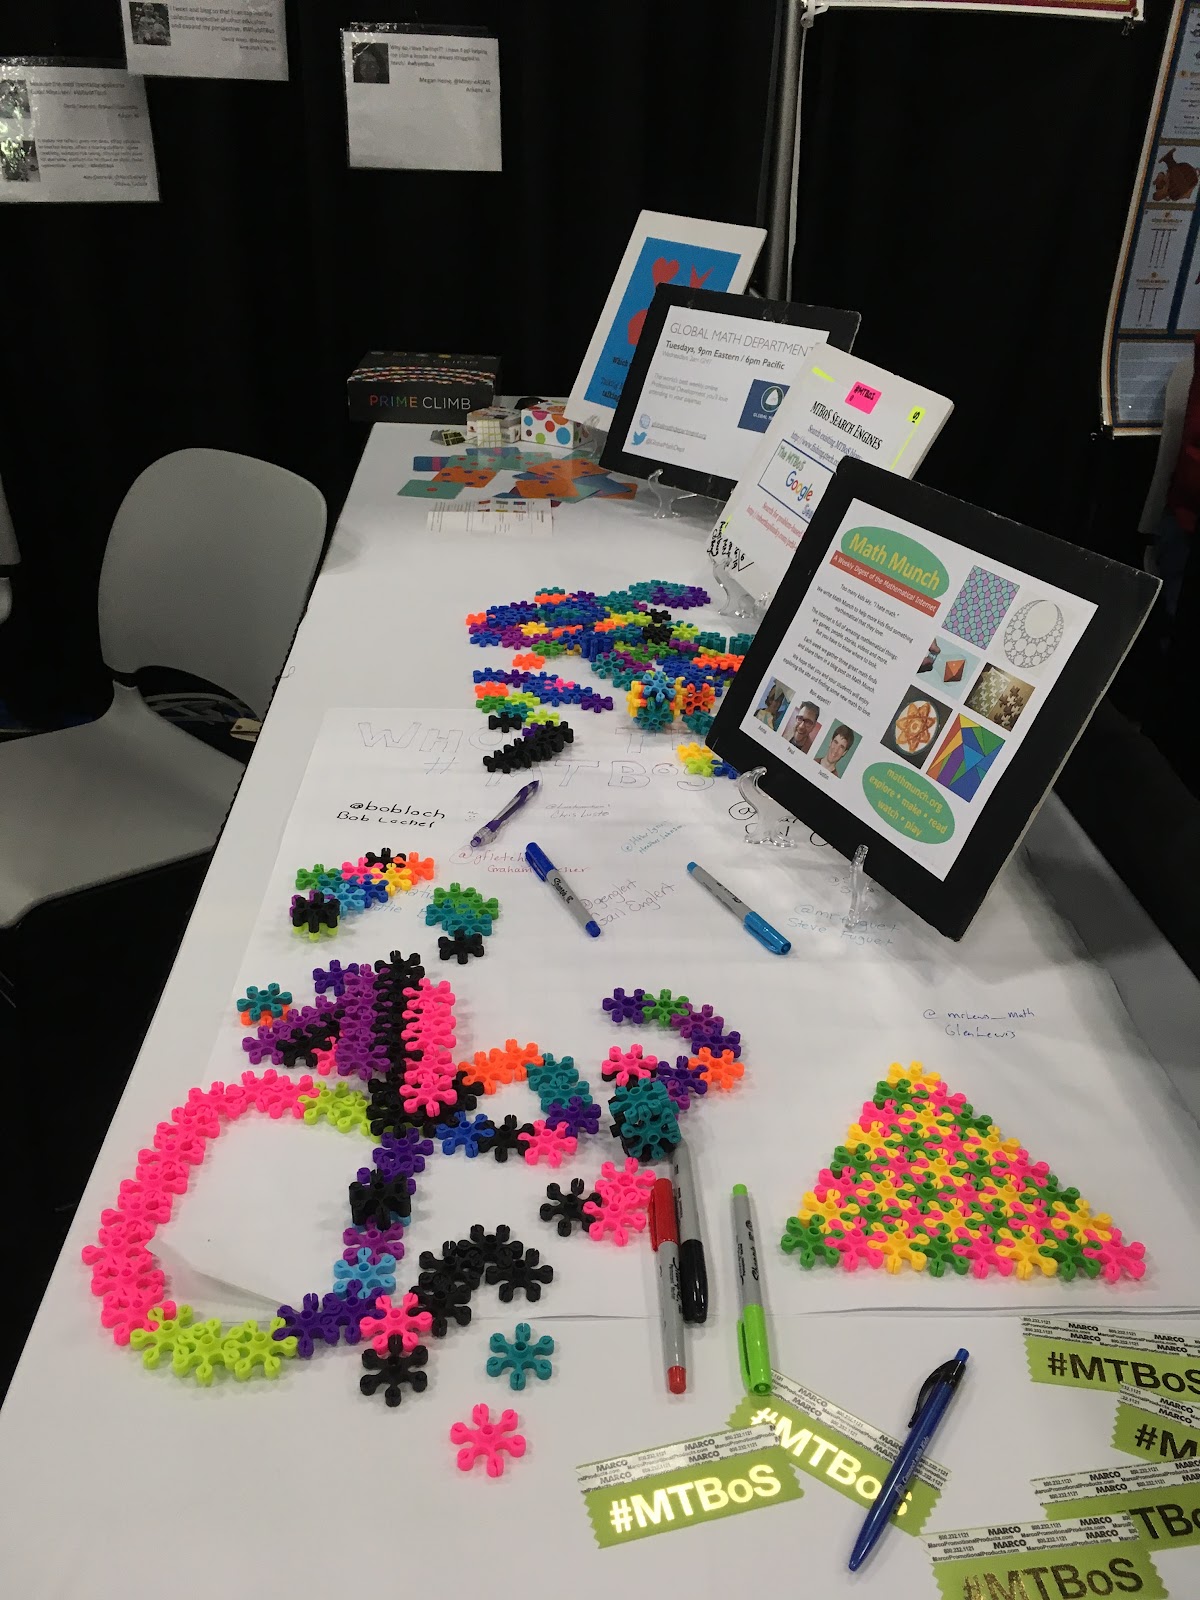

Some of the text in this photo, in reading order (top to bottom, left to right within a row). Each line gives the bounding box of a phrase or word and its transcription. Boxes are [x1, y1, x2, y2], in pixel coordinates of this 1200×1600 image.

[670, 322, 707, 339] GLOBAL
[711, 330, 742, 344] MATH
[611, 355, 629, 367] Which
[666, 340, 784, 369] Tuesdays, 9pm Eastern 6pm Pacific
[370, 395, 471, 410] PRIME CLIMB
[808, 425, 824, 438] Search
[810, 401, 883, 450] MTBoS SEARCH ENGINES
[777, 446, 789, 460] The
[786, 471, 813, 501] Google
[849, 533, 939, 589] Math Munch
[837, 557, 854, 570] Weekly
[853, 565, 869, 578] Digest
[874, 575, 883, 584] the
[883, 580, 915, 600] Mathematical
[915, 596, 936, 612] Internet
[846, 588, 857, 597] many
[876, 604, 885, 612] hate
[834, 606, 858, 621] mathematical
[866, 623, 874, 631] they
[841, 599, 854, 609] Munch
[858, 608, 866, 617] help
[884, 623, 893, 631] find
[892, 628, 913, 643] something
[828, 636, 837, 645] have
[851, 651, 863, 660] where
[845, 627, 860, 639] amazing
[860, 636, 885, 652] mathematical
[798, 657, 807, 665] hope
[803, 636, 812, 644] Each
[826, 651, 838, 659] gather
[838, 657, 848, 666] three
[847, 664, 858, 672] great
[867, 675, 877, 684] finds
[817, 769, 828, 779] Justin
[887, 769, 942, 812] mathmunch.org
[350, 801, 445, 819] @bobloch
[869, 776, 947, 833] explore make read
[337, 811, 370, 821] Bob
[877, 800, 921, 836] watch play
[449, 845, 527, 864] @gfletch
[787, 918, 827, 933] Steve
[1068, 1323, 1098, 1331] MARCO
[1154, 1334, 1185, 1343] MARCO
[1071, 1333, 1188, 1353] MARCO MARCO
[792, 1397, 822, 1416] MARCO
[798, 1388, 828, 1408] MARCO
[1160, 1398, 1193, 1413] MARCO
[1159, 1408, 1192, 1424] MARCO
[596, 1439, 715, 1472] MARCO MARCO
[600, 1472, 632, 1484] MARCO
[688, 1451, 720, 1463] MARCO
[1043, 1471, 1120, 1486] 800.232.1121 MARCO
[610, 1465, 781, 1533] #MTBoS
[1049, 1484, 1128, 1499] 800.232.1121 MARCO
[988, 1526, 1021, 1536] MARCO
[1031, 1523, 1062, 1531] 800.232.1121
[1080, 1516, 1112, 1526] MARCO
[994, 1540, 1027, 1549] MARCO
[1086, 1529, 1119, 1539] MARCO
[962, 1557, 1143, 1600] #MTBoS
